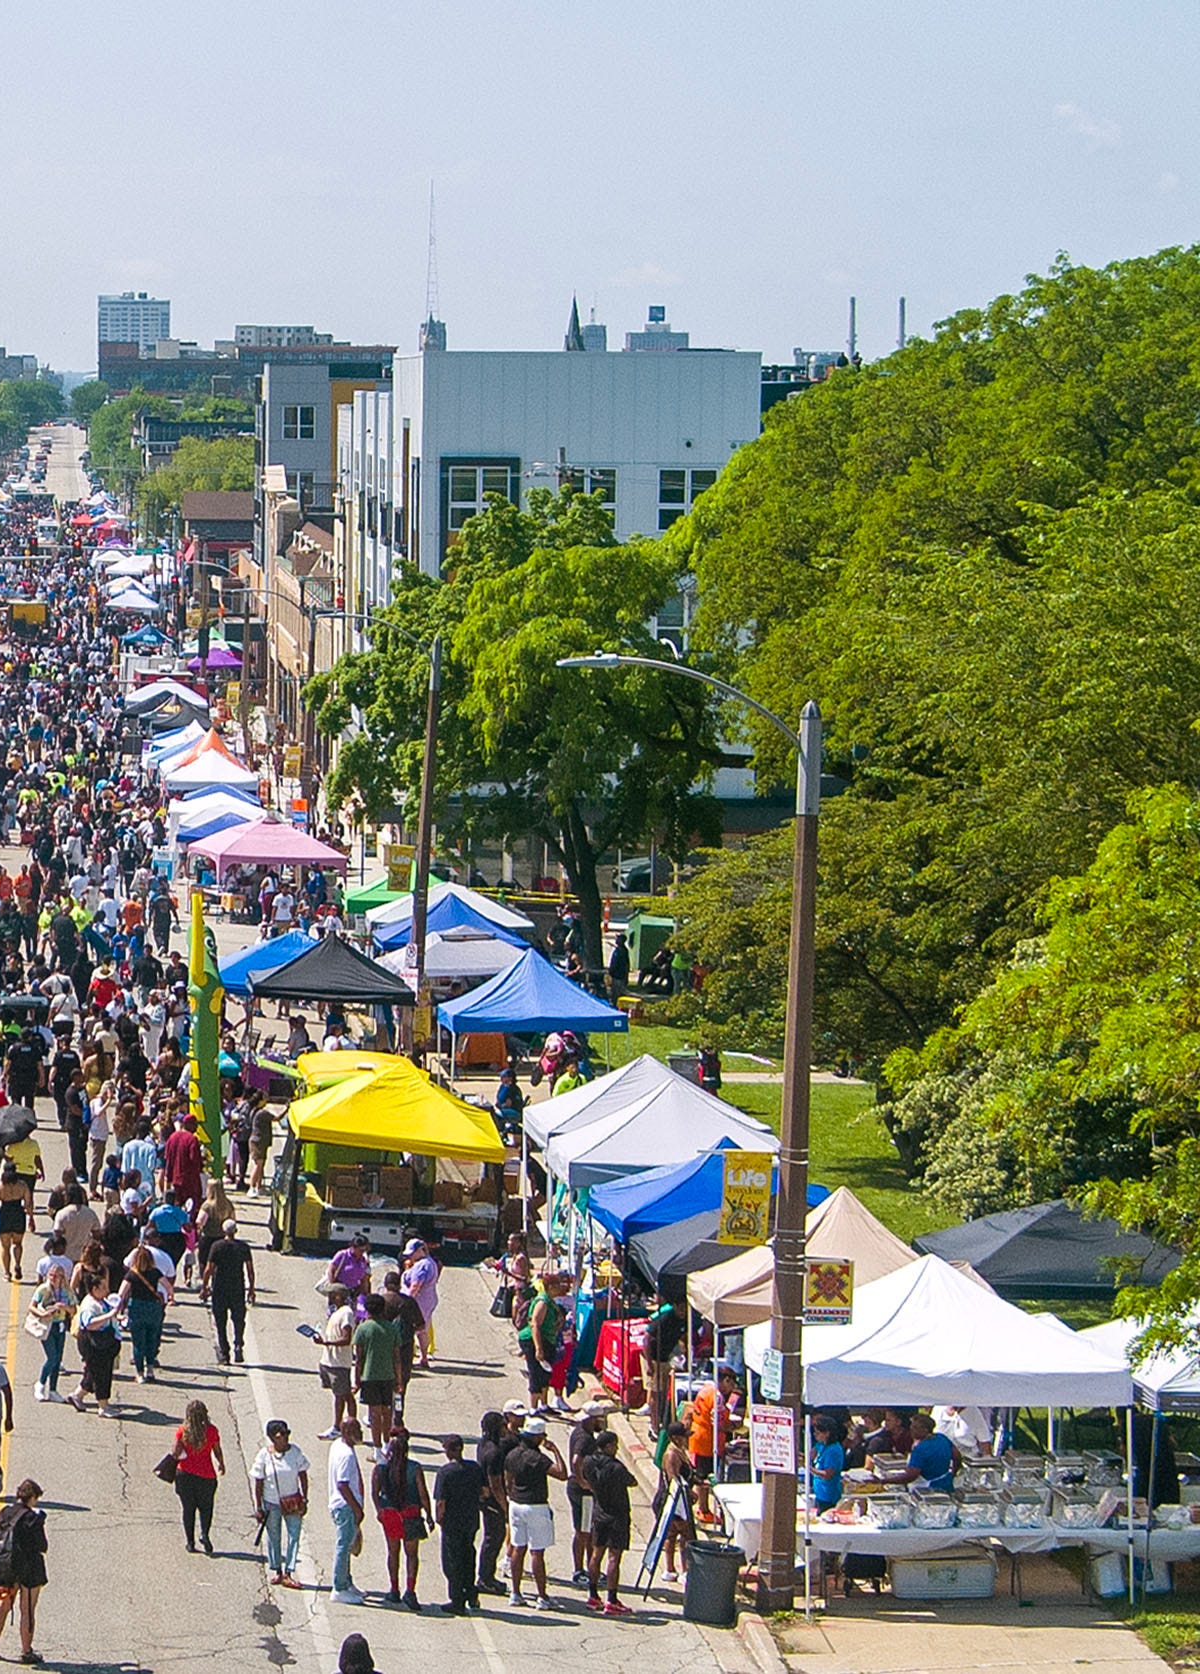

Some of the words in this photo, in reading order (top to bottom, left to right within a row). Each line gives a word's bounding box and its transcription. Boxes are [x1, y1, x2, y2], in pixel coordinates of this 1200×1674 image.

[727, 1169, 767, 1187] Life
[767, 1425, 776, 1433] NO
[756, 1432, 790, 1443] PARKING
